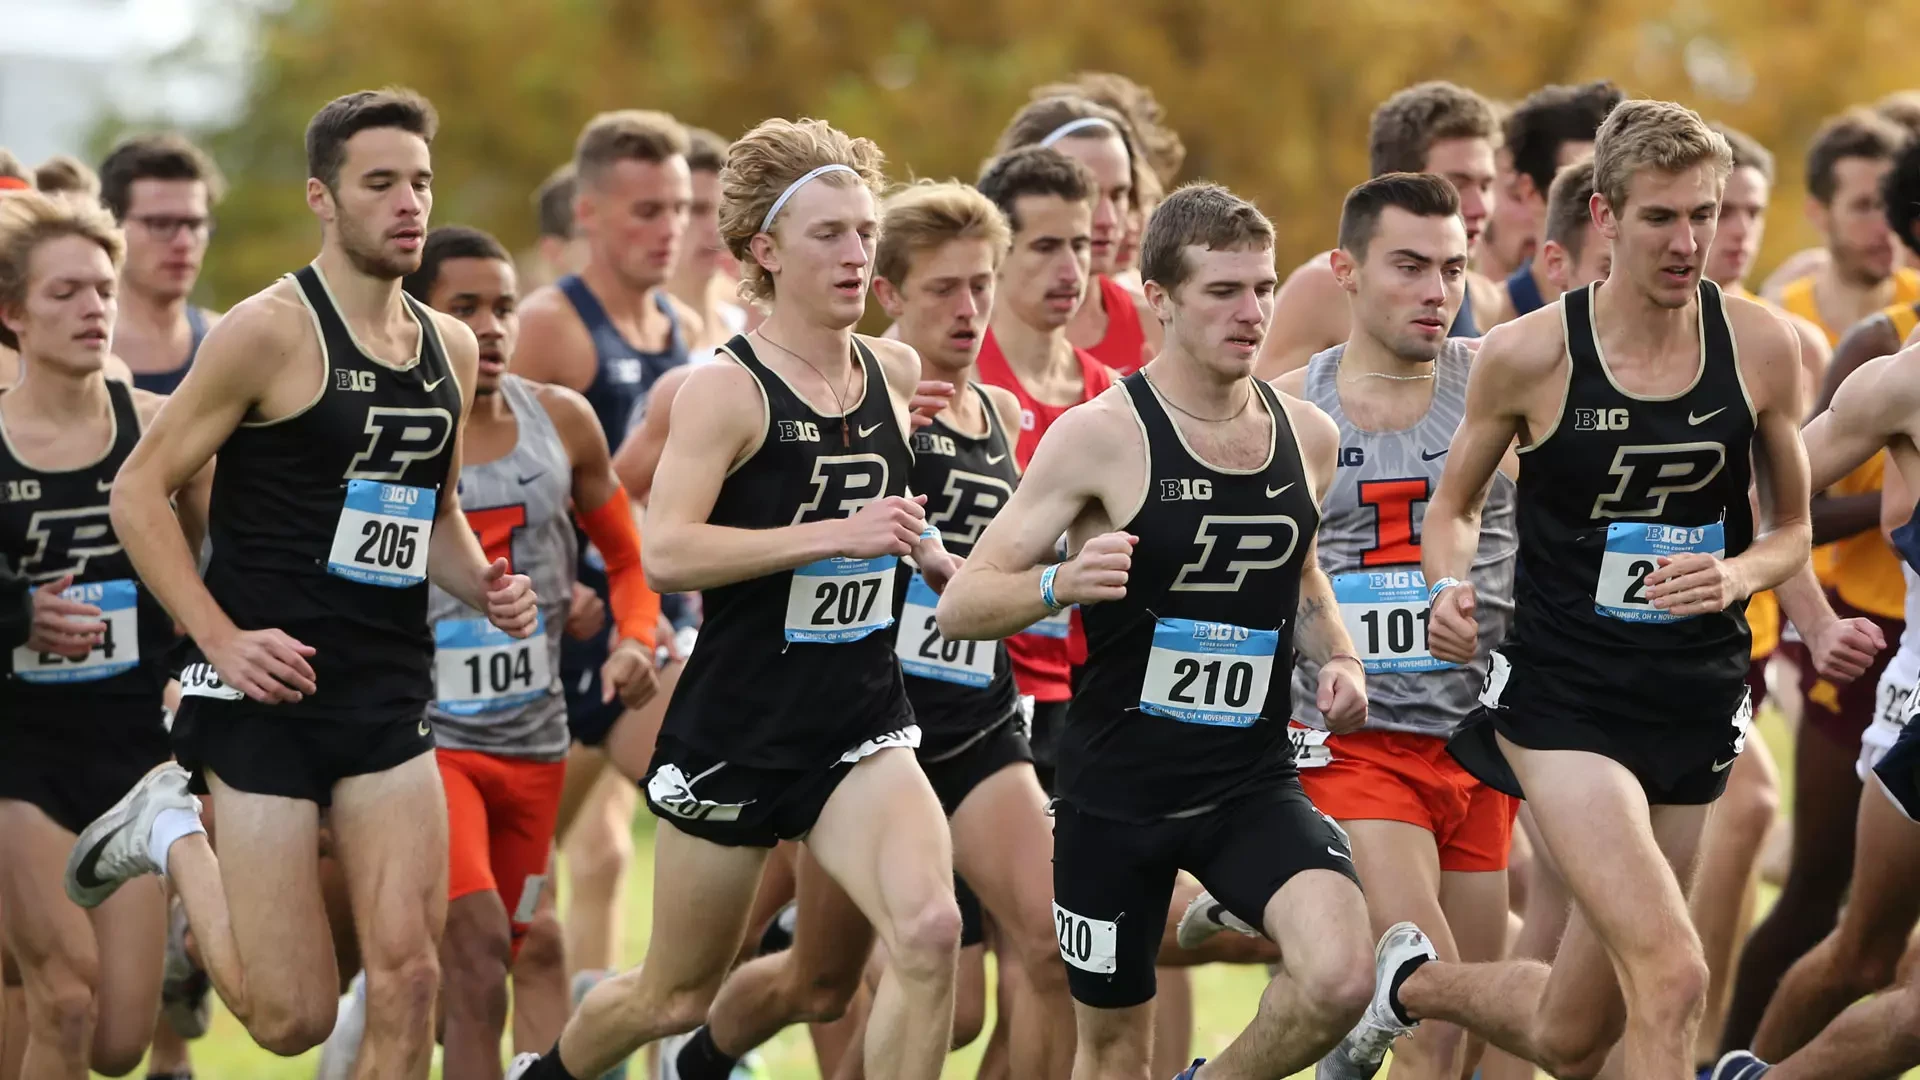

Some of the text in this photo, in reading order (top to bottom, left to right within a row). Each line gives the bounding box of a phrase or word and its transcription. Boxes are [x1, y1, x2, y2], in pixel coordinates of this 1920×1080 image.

[342, 406, 453, 480] P
[789, 452, 889, 526] P
[928, 469, 1016, 545] P
[1590, 441, 1726, 520] P
[17, 505, 124, 581] P
[354, 519, 420, 569] 205
[1168, 514, 1299, 592] P
[1358, 477, 1429, 569] I
[811, 578, 882, 625] 207
[1361, 607, 1430, 654] 101
[465, 647, 533, 695] 104
[1168, 658, 1254, 708] 210
[1202, 713, 1236, 723] NOVEMBER
[1057, 910, 1092, 962] 210
